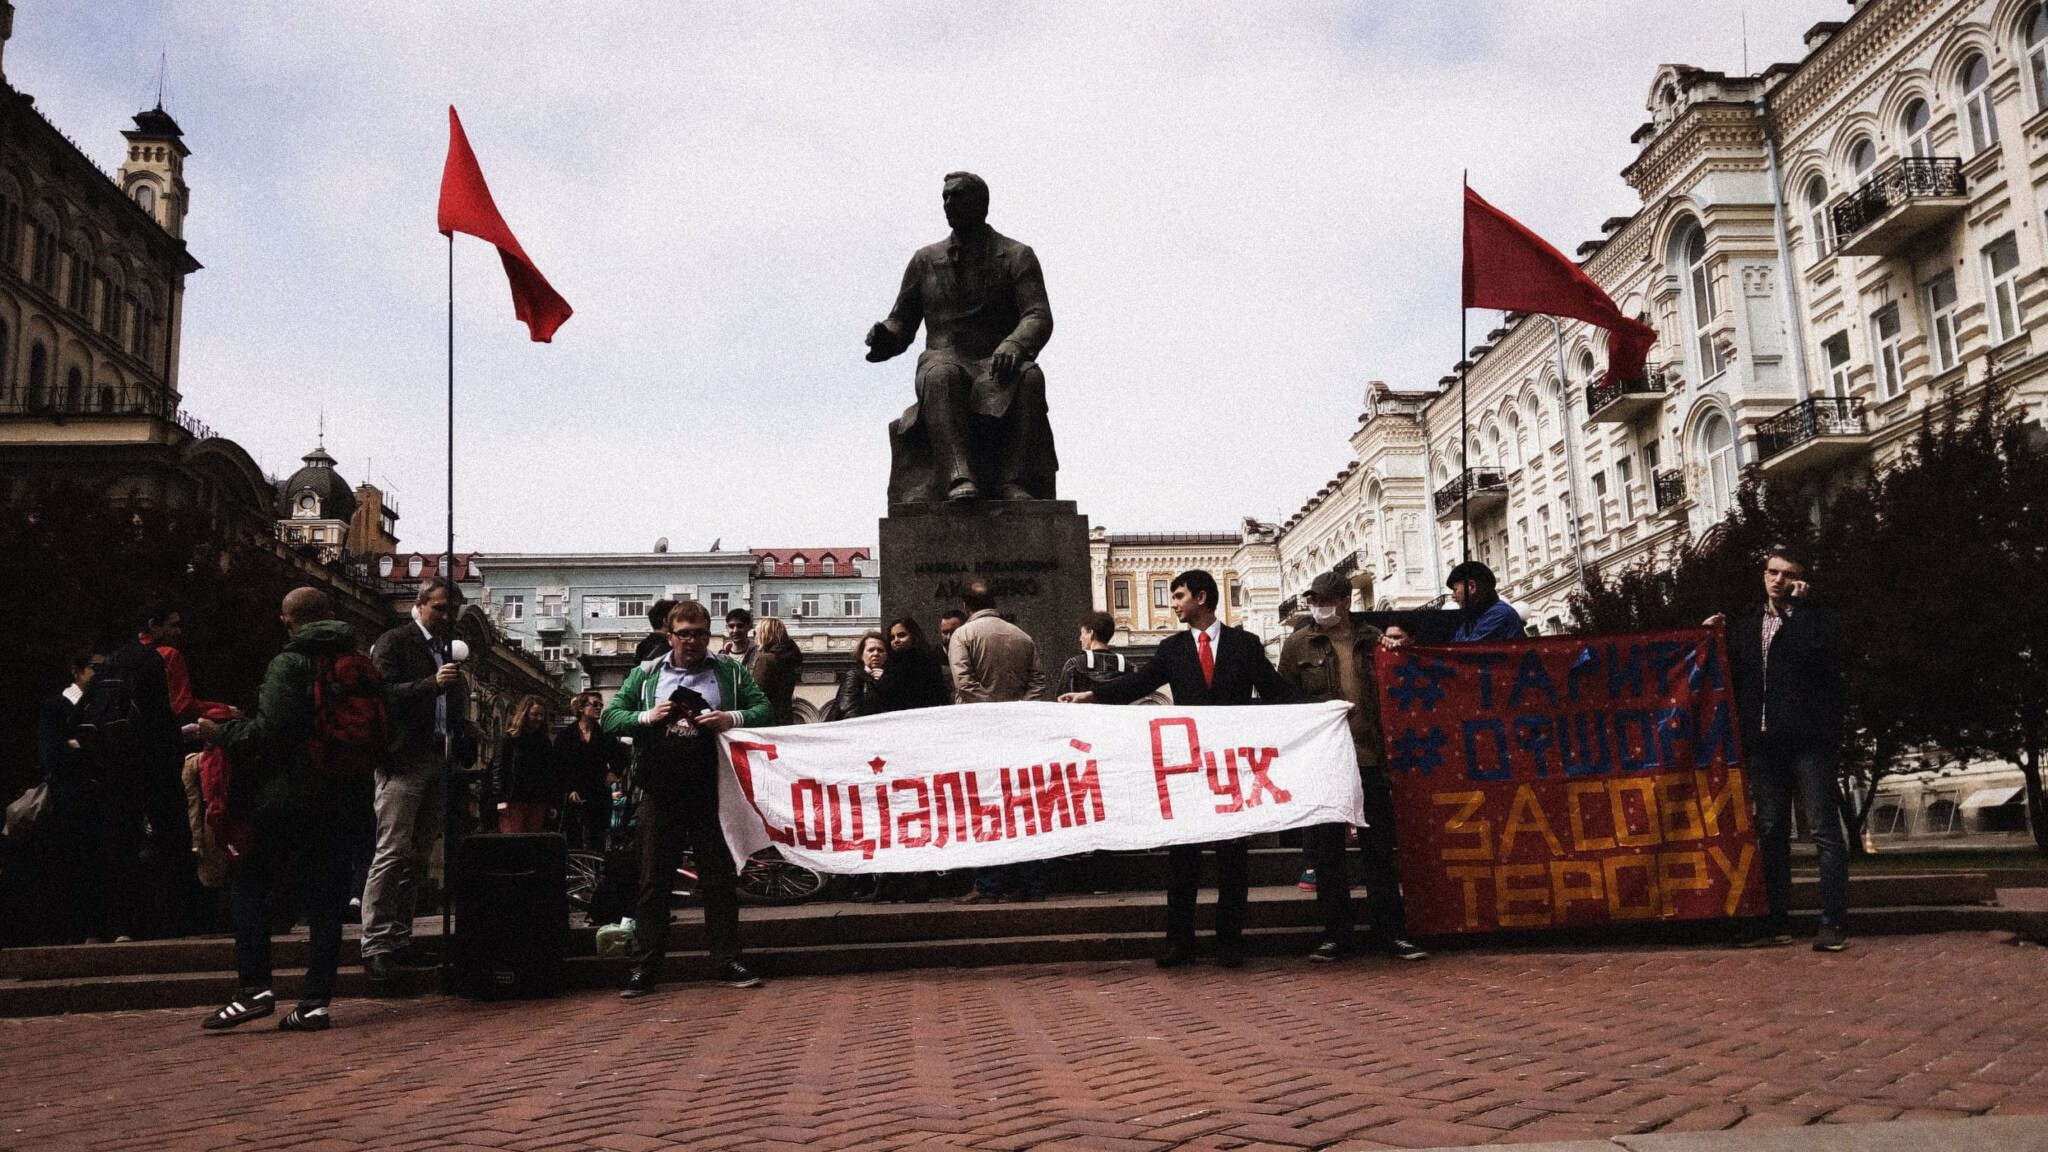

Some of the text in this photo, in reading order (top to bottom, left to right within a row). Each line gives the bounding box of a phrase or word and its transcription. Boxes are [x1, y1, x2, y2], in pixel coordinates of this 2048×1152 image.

[729, 716, 1292, 860] Соціальний Рух
[1431, 768, 1750, 861] ЗАСОБИ
[1445, 842, 1756, 928] ТЕРОРУ
